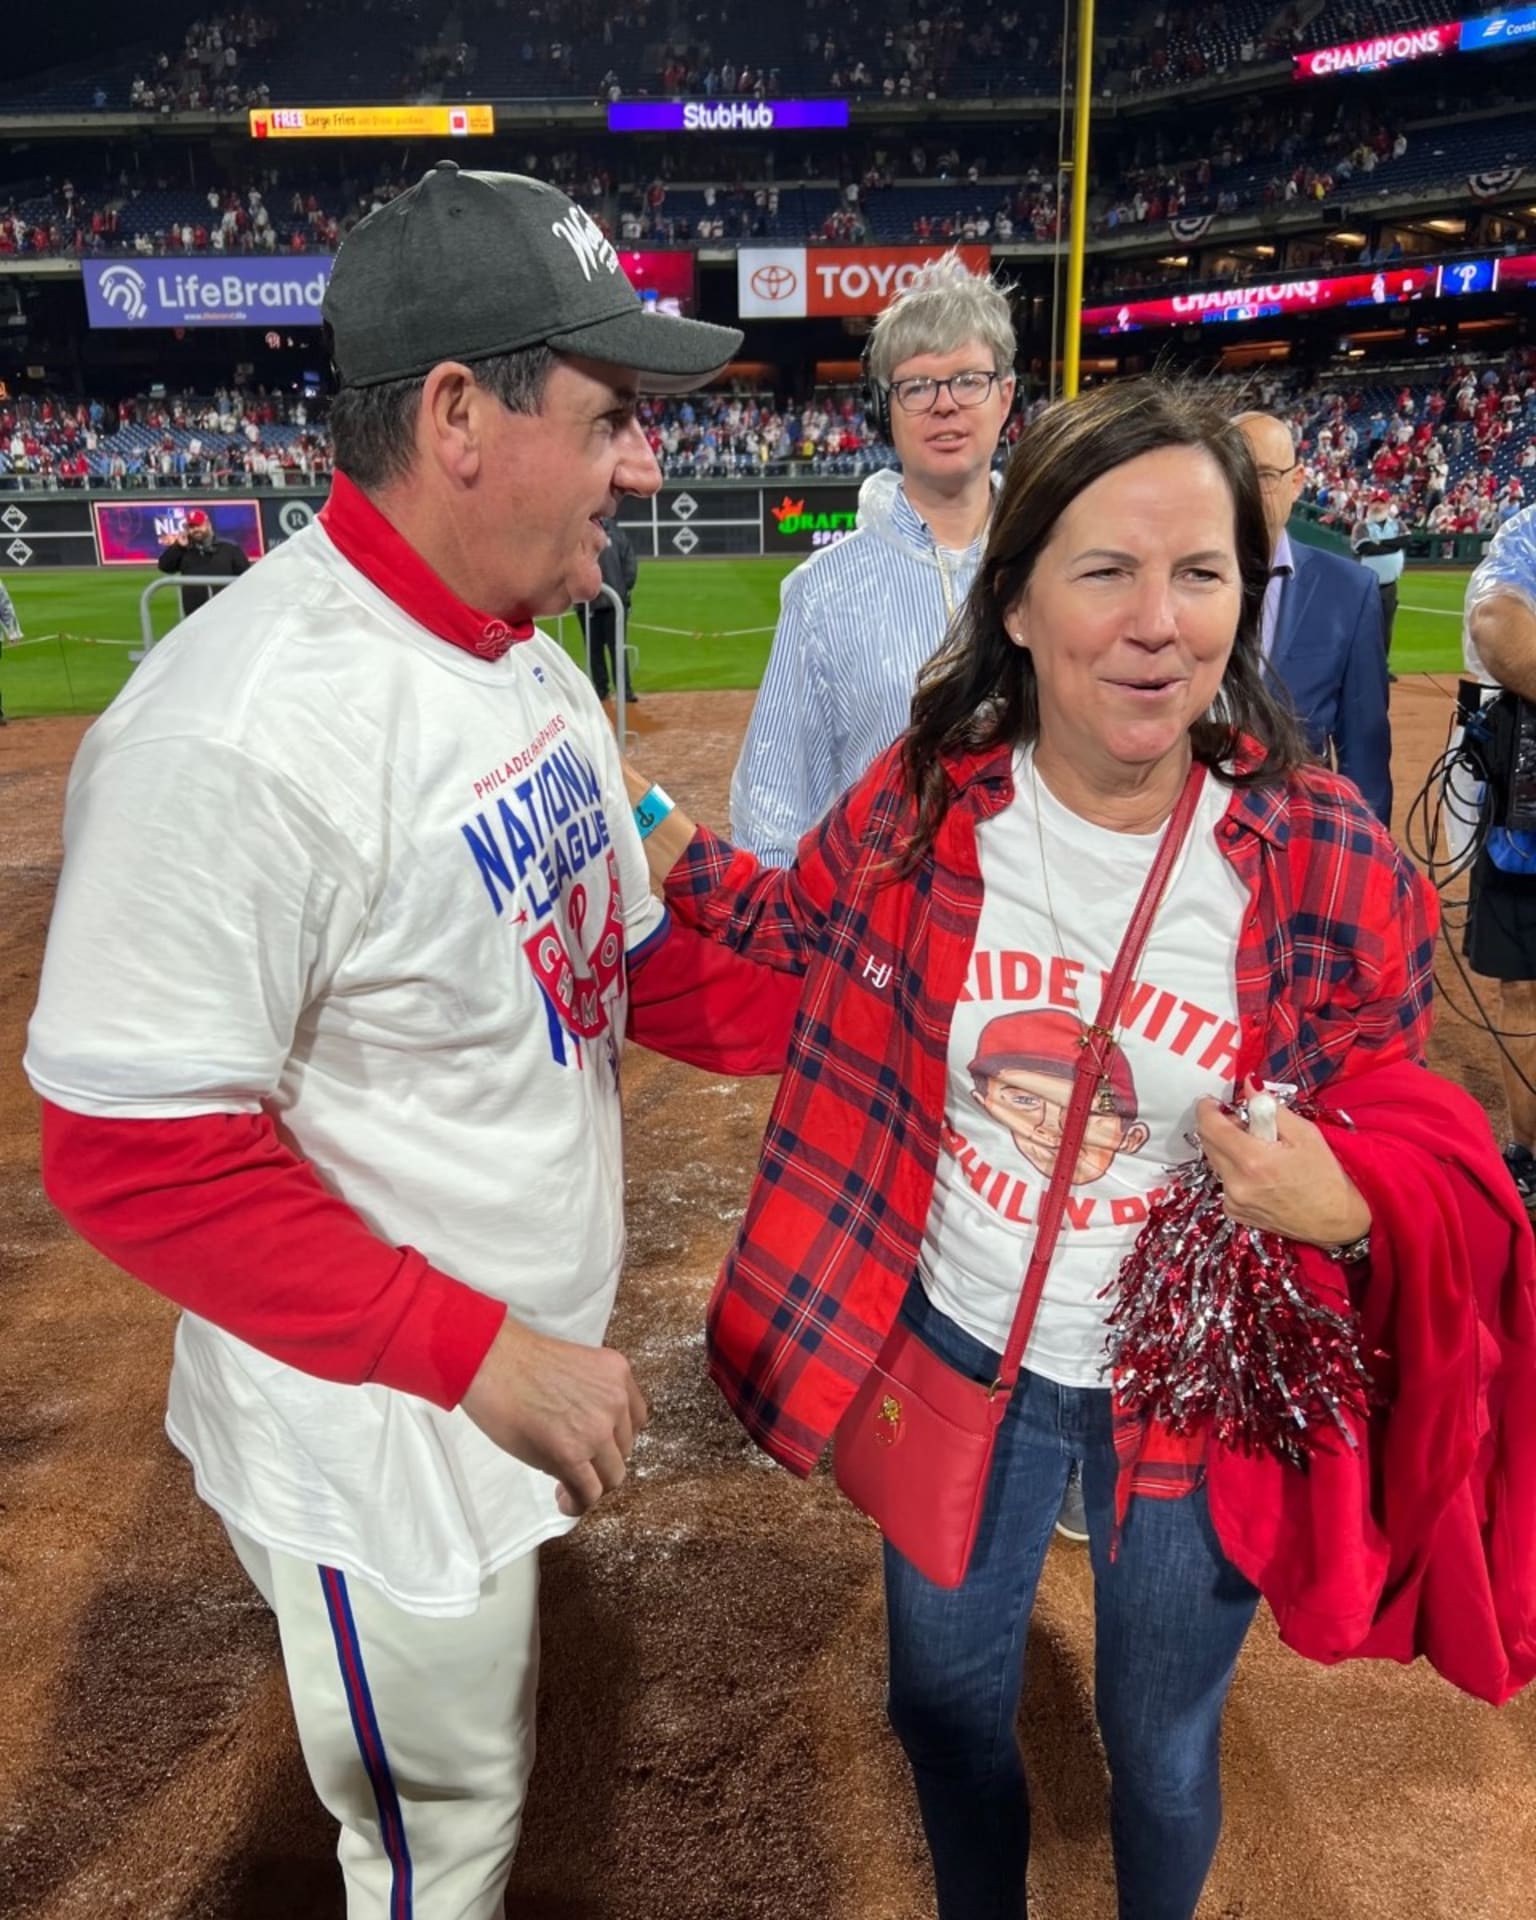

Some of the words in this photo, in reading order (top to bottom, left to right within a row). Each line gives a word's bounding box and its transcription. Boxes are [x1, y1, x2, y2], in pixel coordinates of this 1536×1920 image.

[1311, 30, 1441, 75] CHAMPIONS
[683, 102, 773, 129] StubHub
[158, 273, 326, 308] LifeBrand
[816, 263, 969, 298] TOYO
[461, 740, 602, 917] NATIONA
[525, 809, 612, 920] LEAGUE
[959, 950, 1085, 1009] IDE
